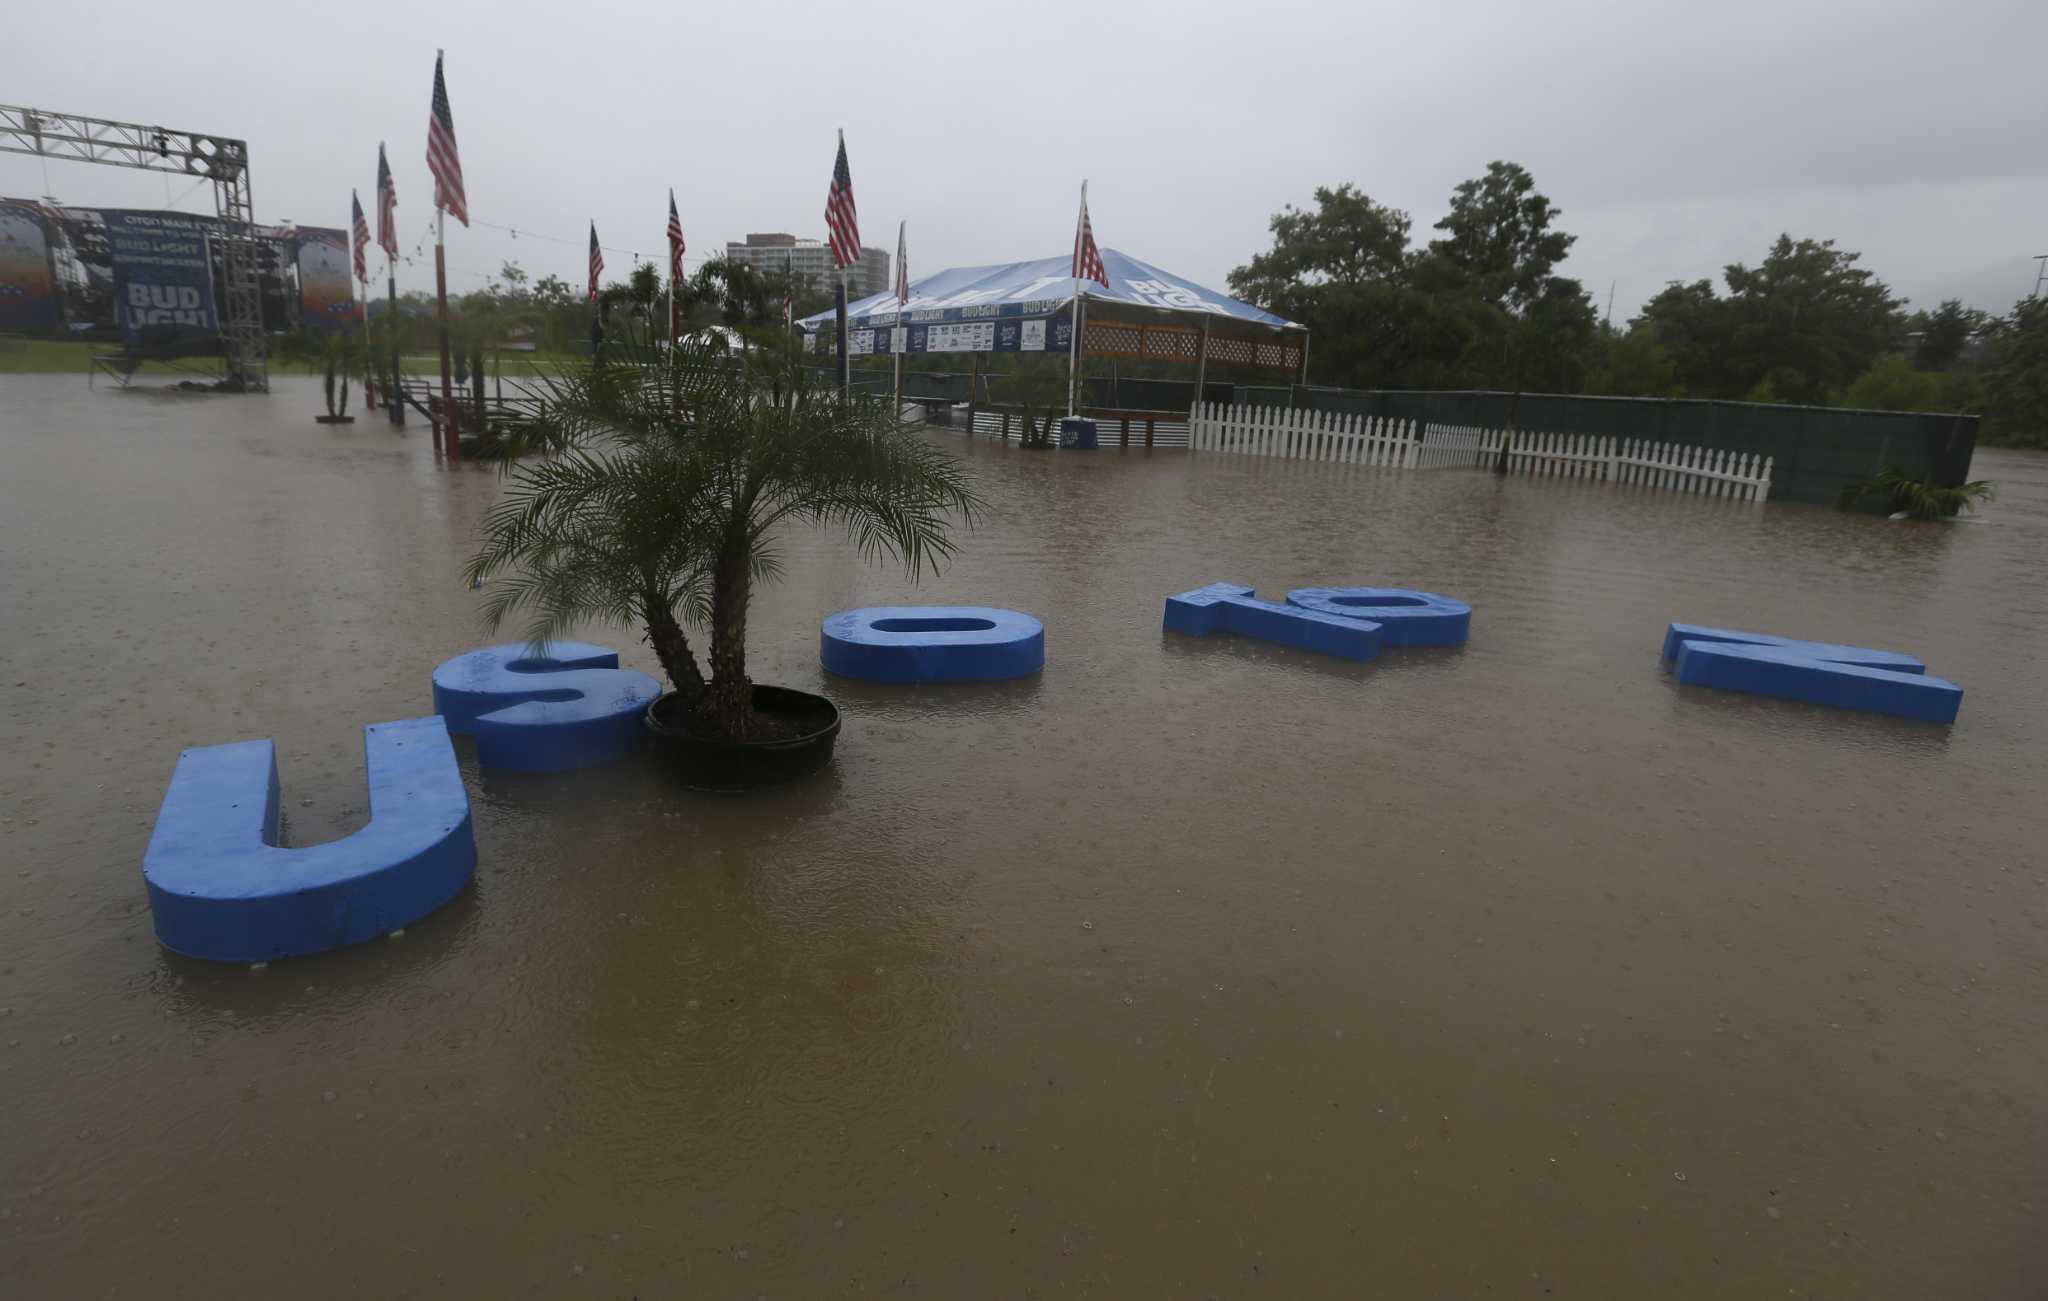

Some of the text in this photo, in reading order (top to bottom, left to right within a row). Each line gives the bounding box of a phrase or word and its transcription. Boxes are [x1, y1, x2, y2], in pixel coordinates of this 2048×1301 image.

[114, 238, 198, 255] BUD LIGHT
[128, 283, 201, 309] BUD
[143, 715, 478, 964] U
